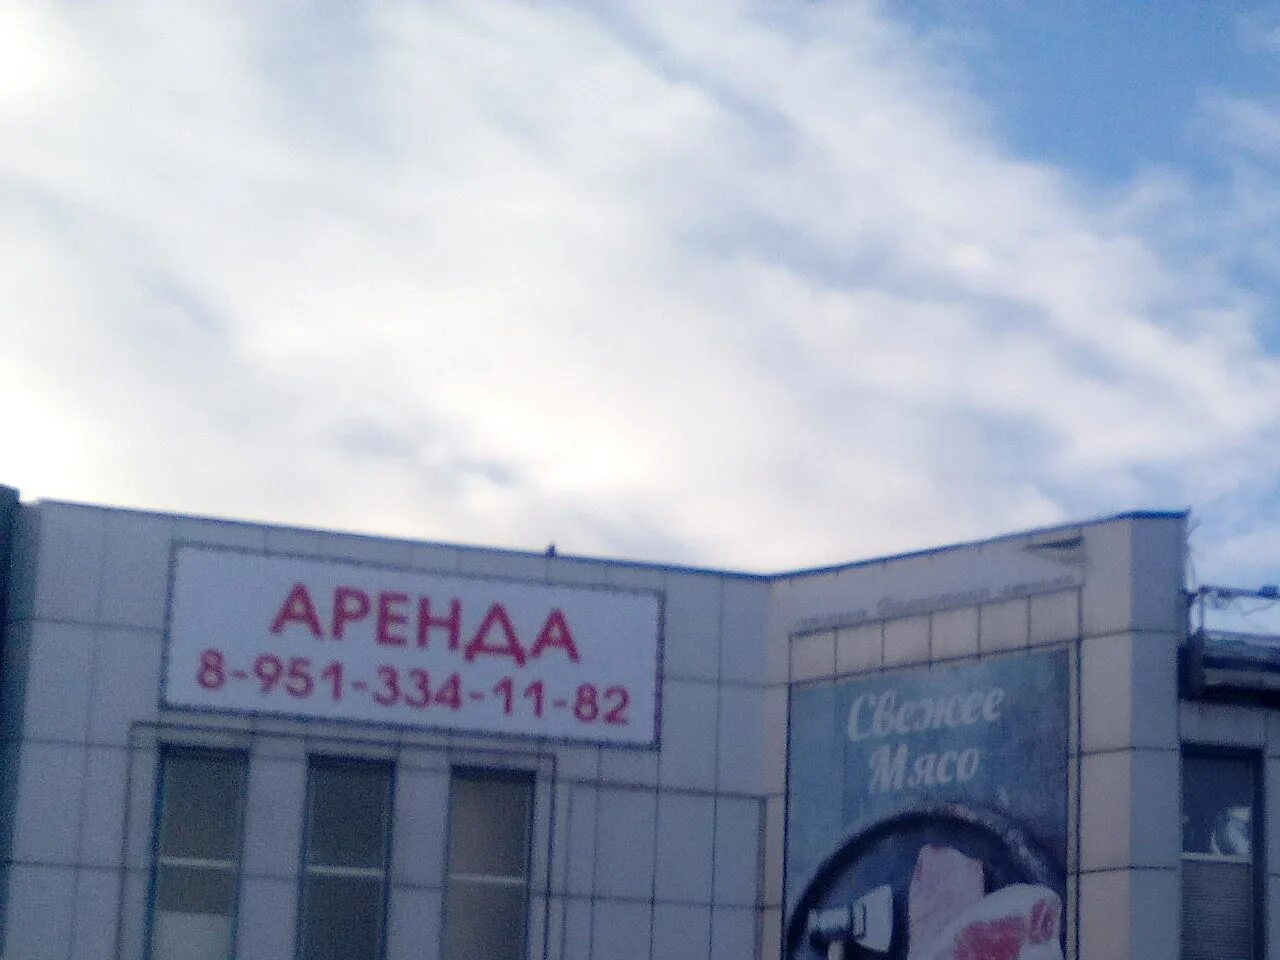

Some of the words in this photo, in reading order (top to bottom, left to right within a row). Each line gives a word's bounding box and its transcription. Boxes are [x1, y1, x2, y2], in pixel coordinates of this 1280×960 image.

[270, 582, 581, 668] АРЕНДА
[196, 648, 631, 726] 8-951-334-11-82
[847, 686, 1004, 742] Свежее
[868, 743, 979, 795] Мясо
